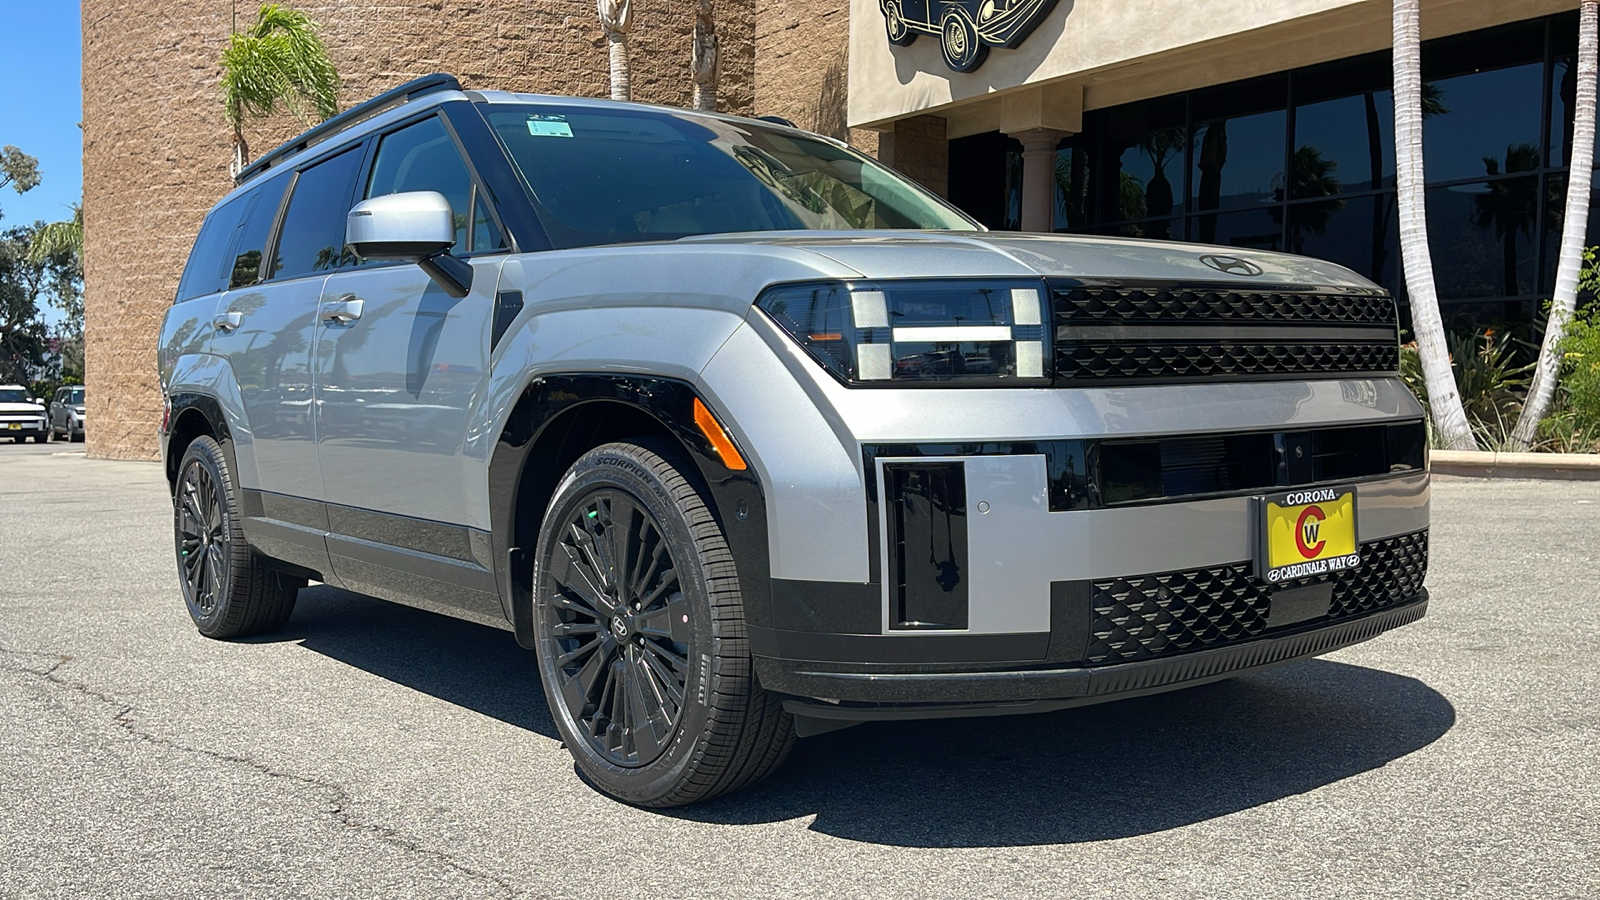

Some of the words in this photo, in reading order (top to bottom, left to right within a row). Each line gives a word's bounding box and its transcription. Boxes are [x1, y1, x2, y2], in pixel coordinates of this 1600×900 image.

[595, 457, 653, 484] SCORPION
[1286, 489, 1336, 505] CORONA
[1295, 505, 1327, 559] C
[1304, 521, 1320, 544] W
[1280, 560, 1328, 580] CARDINALE
[1328, 556, 1348, 571] WAY
[698, 654, 711, 706] PIRELLI
